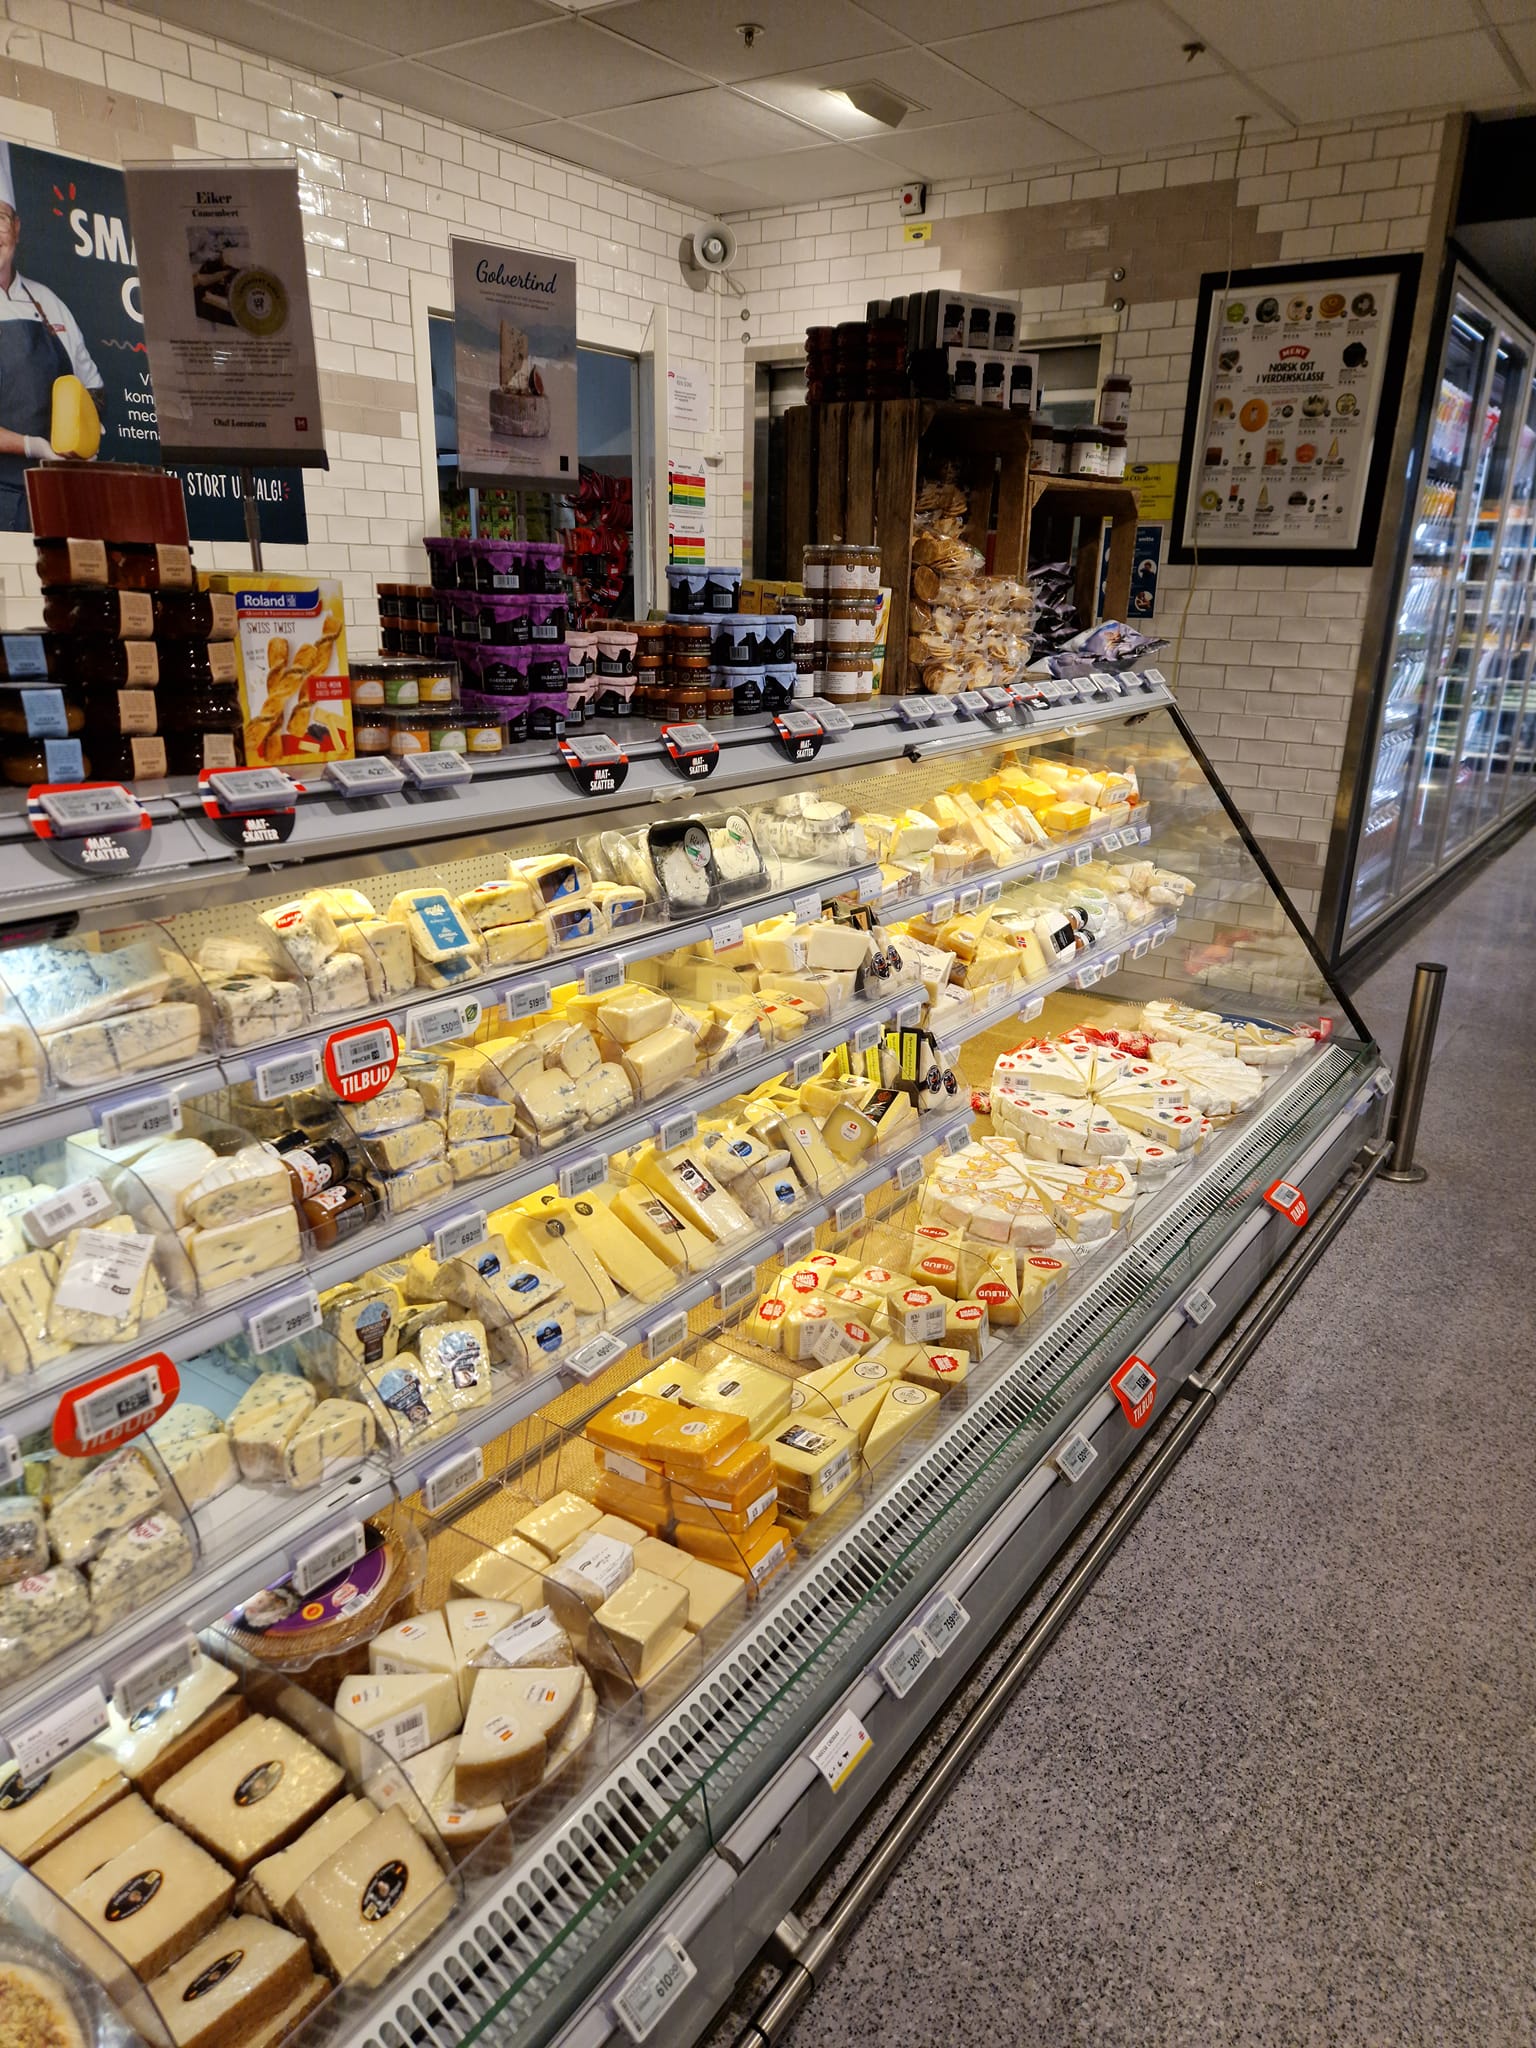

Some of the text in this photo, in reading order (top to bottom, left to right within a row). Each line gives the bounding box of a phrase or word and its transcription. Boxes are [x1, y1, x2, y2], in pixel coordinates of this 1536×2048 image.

[196, 191, 232, 204] Eiker
[70, 208, 138, 266] SM
[476, 259, 557, 294] Golvertind
[1299, 361, 1315, 371] OST
[139, 372, 152, 386] V
[1262, 371, 1325, 383] VERDENSKLASSE
[187, 471, 283, 501] STORT UALG!
[244, 594, 285, 607] Roland
[246, 622, 296, 634] SWISS TWIST
[594, 769, 611, 780] MAT-
[689, 764, 709, 775] SKATTER
[590, 779, 615, 791] SKATTER
[245, 818, 270, 831] MAT-
[242, 829, 280, 842] SKATTER
[85, 837, 117, 850] MAT-
[81, 847, 130, 863] SKATTER
[341, 1064, 391, 1096] TILBUD
[923, 1261, 953, 1271] TILBUD
[978, 1289, 1010, 1298] TILBUD
[1133, 1390, 1154, 1423] TILBUD
